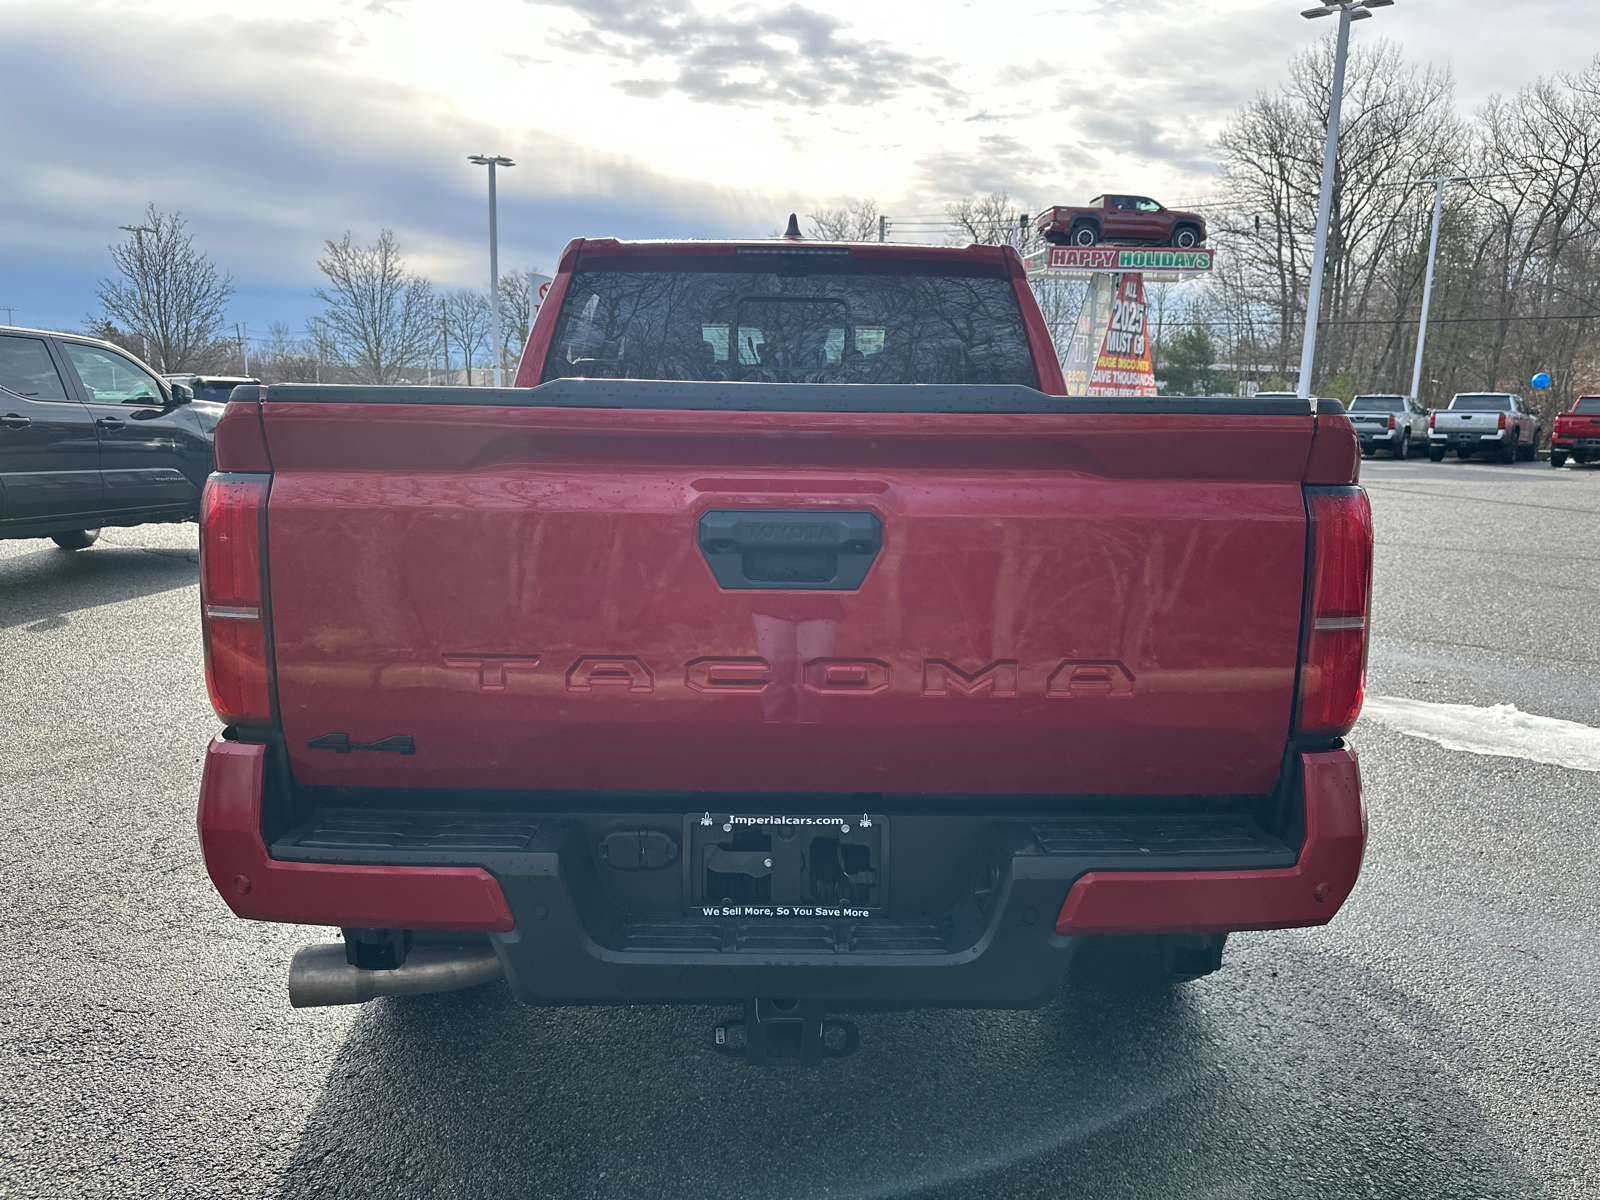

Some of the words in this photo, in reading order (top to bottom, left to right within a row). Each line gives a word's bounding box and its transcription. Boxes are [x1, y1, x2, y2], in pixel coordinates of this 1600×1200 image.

[1051, 249, 1116, 267] HAPPY
[1118, 251, 1211, 268] HOLIDAYS
[1125, 282, 1138, 299] ALL
[1112, 299, 1145, 334] 2025
[1106, 330, 1133, 354] MUST
[1134, 334, 1145, 355] GO
[1097, 356, 1117, 369] HUGE
[1118, 357, 1150, 371] DISCOUNTS
[1091, 370, 1111, 383] SAVE
[1112, 371, 1155, 387] THOUSANDS
[747, 524, 835, 541] TOYOTA
[438, 651, 1137, 699] TACOMA
[729, 814, 844, 827] Imperialcars.com
[702, 907, 720, 916] We
[722, 907, 742, 916] Sell
[744, 907, 774, 917] More,
[776, 907, 790, 916] So
[792, 907, 813, 916] You
[815, 907, 841, 917] Save
[843, 908, 870, 918] More
